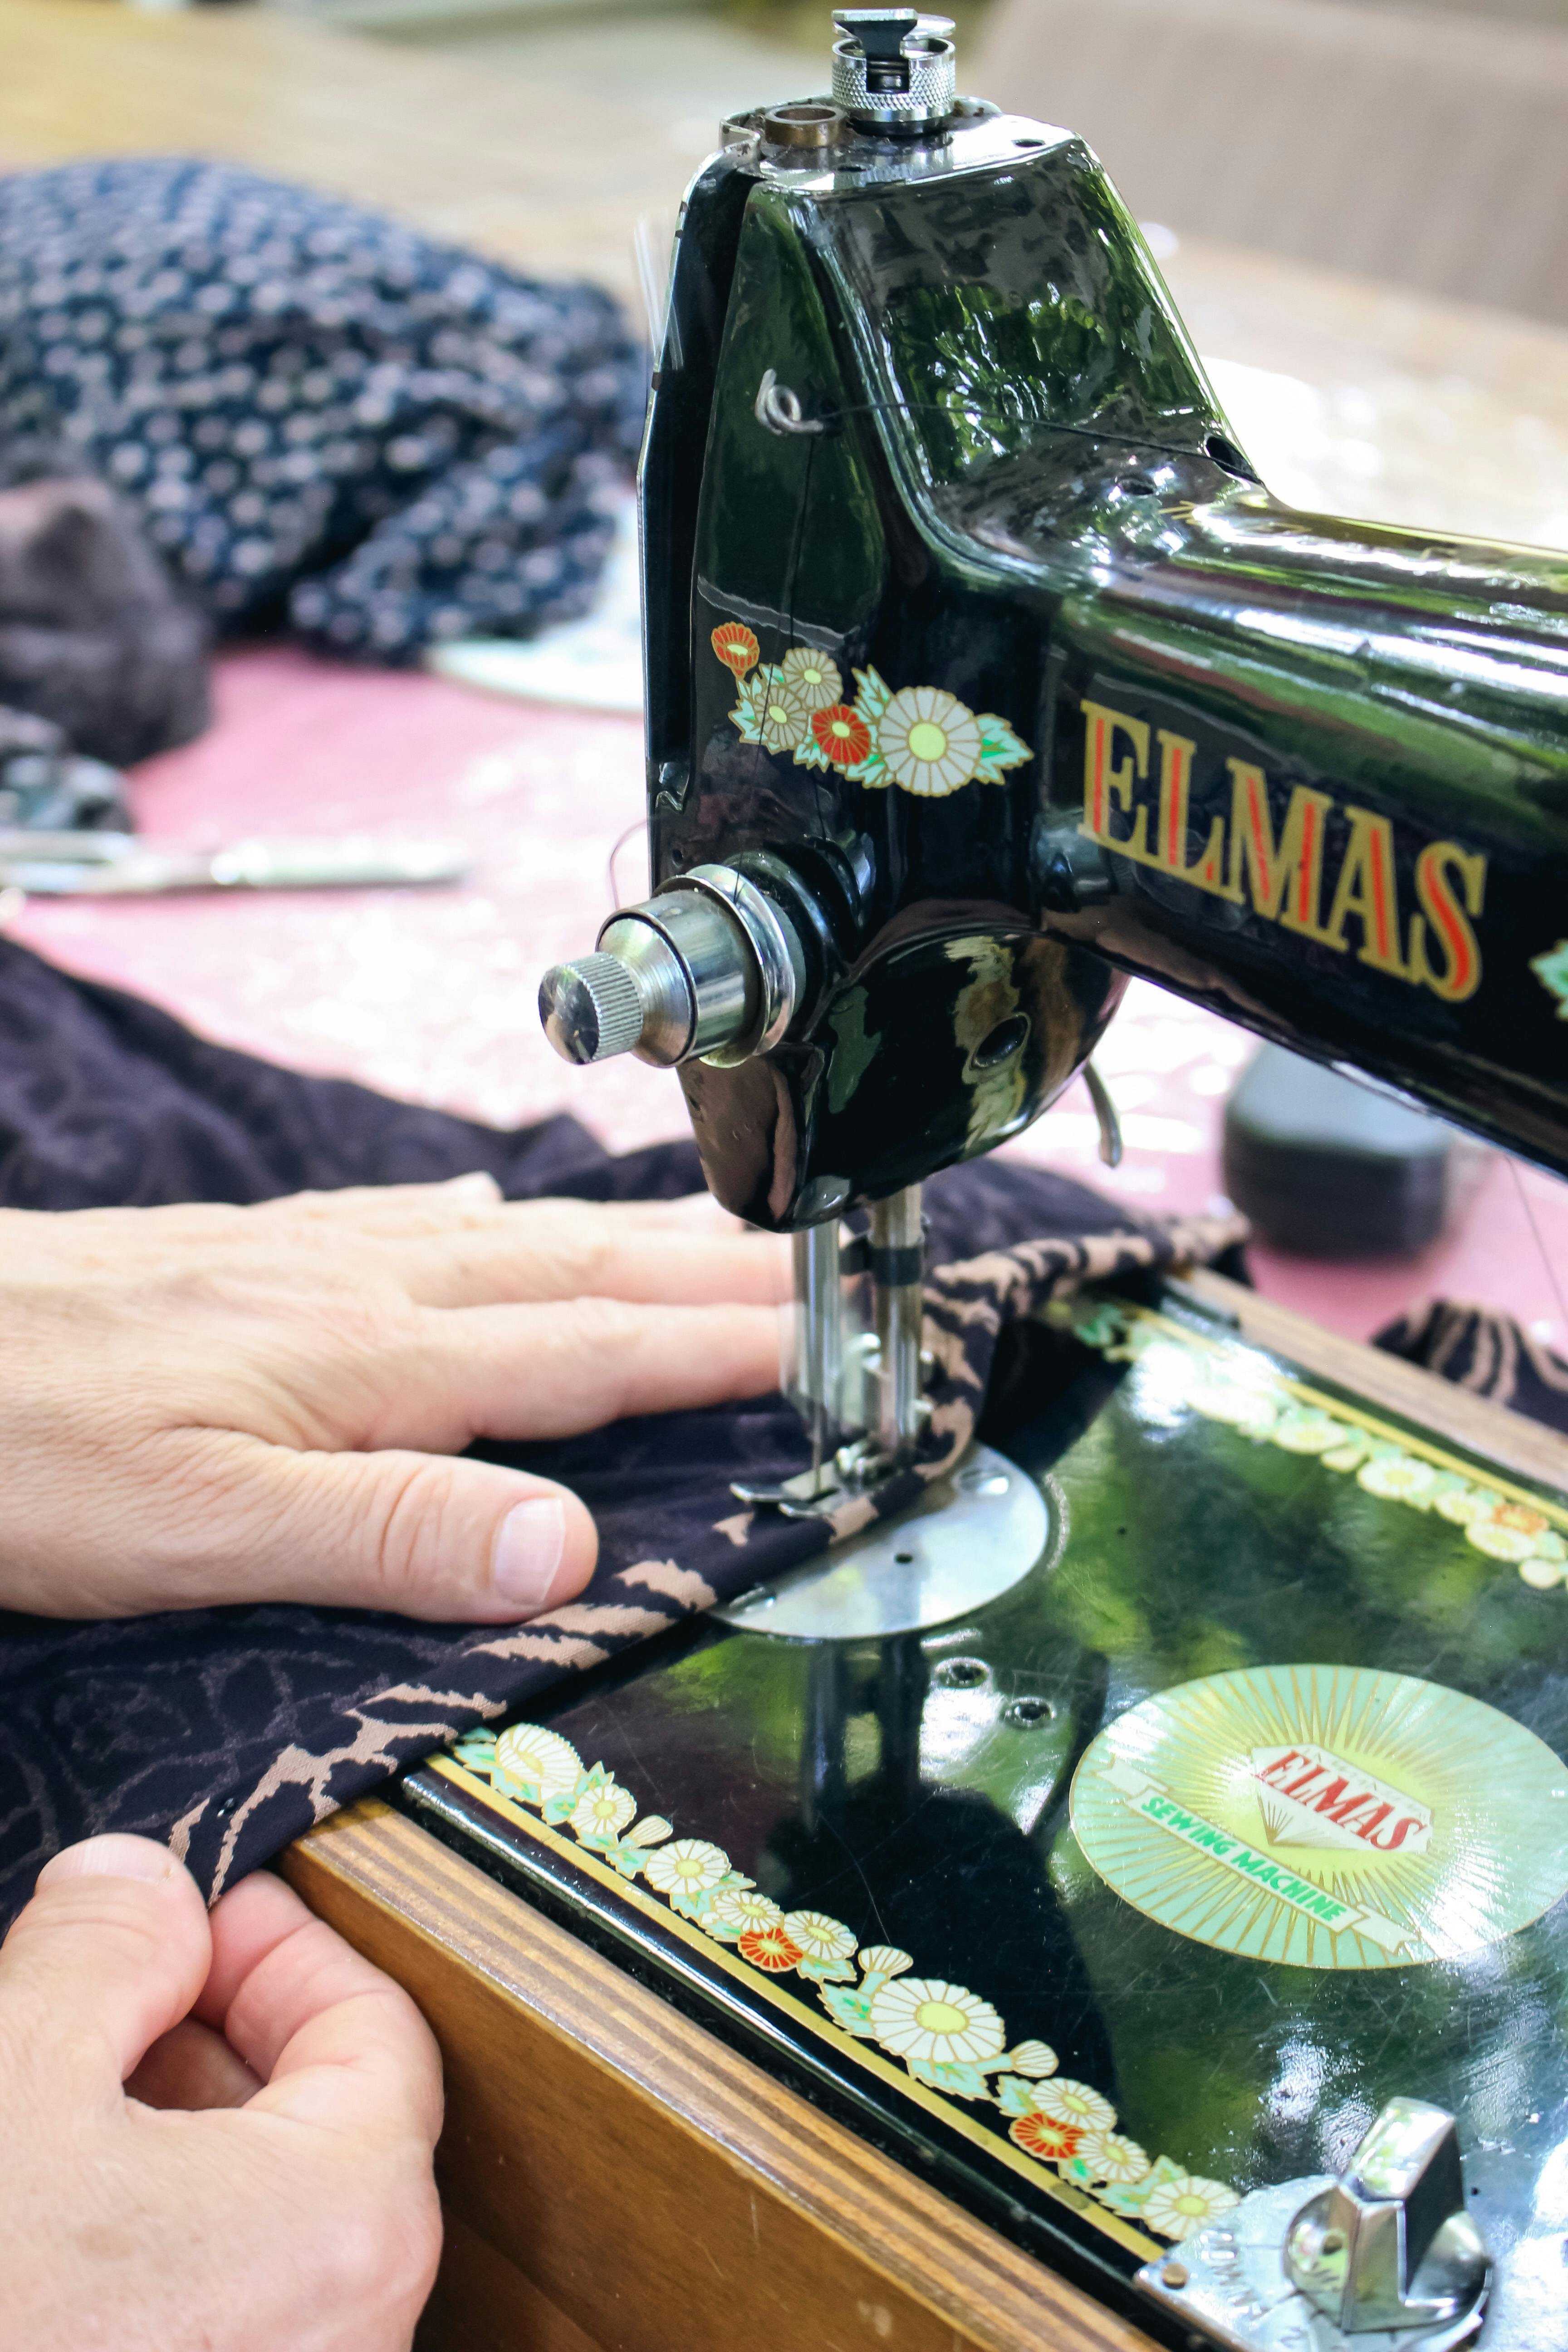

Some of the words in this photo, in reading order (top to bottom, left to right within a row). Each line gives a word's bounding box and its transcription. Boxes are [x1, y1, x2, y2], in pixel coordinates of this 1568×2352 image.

[1077, 699, 1488, 1003] ELMAS
[1141, 1796, 1238, 1855] SEWING
[1230, 1850, 1347, 1922] MACHINE
[1251, 1749, 1429, 1851] ELMAS
